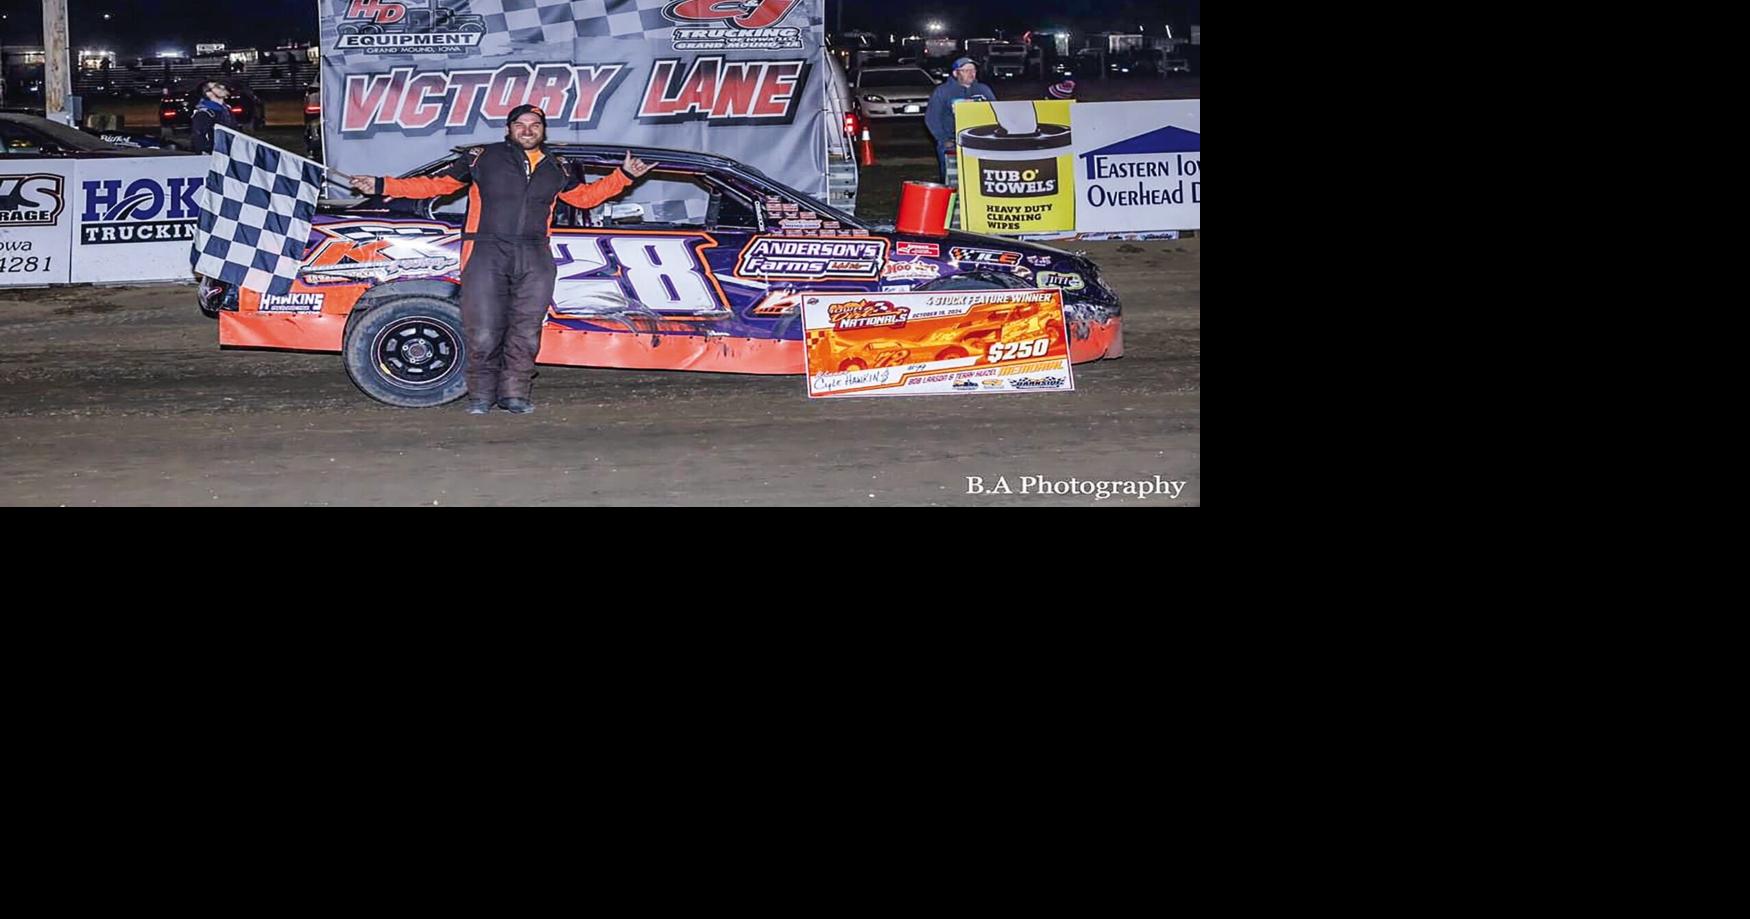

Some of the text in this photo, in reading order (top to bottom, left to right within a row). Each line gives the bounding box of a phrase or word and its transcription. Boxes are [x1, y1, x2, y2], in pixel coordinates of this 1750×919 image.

[679, 28, 799, 38] TRUCKING
[346, 34, 473, 46] EQUIPMENT
[341, 57, 806, 132] VICTORY LANE
[983, 169, 1039, 181] TUB O'
[984, 180, 1054, 193] TOWELS
[986, 203, 1053, 213] HEAVY DUTY
[986, 213, 1042, 222] CLEANING
[987, 221, 1020, 230] WIPES
[754, 241, 877, 257] ANDERSON'S
[746, 258, 823, 272] Farms
[550, 237, 717, 311] 28
[259, 293, 324, 310] HAWKINS
[968, 294, 1009, 304] FEATURE
[1010, 293, 1052, 303] WINNER
[840, 314, 907, 328] NATIONALS
[987, 338, 1049, 363] $250
[908, 377, 922, 386] BOB
